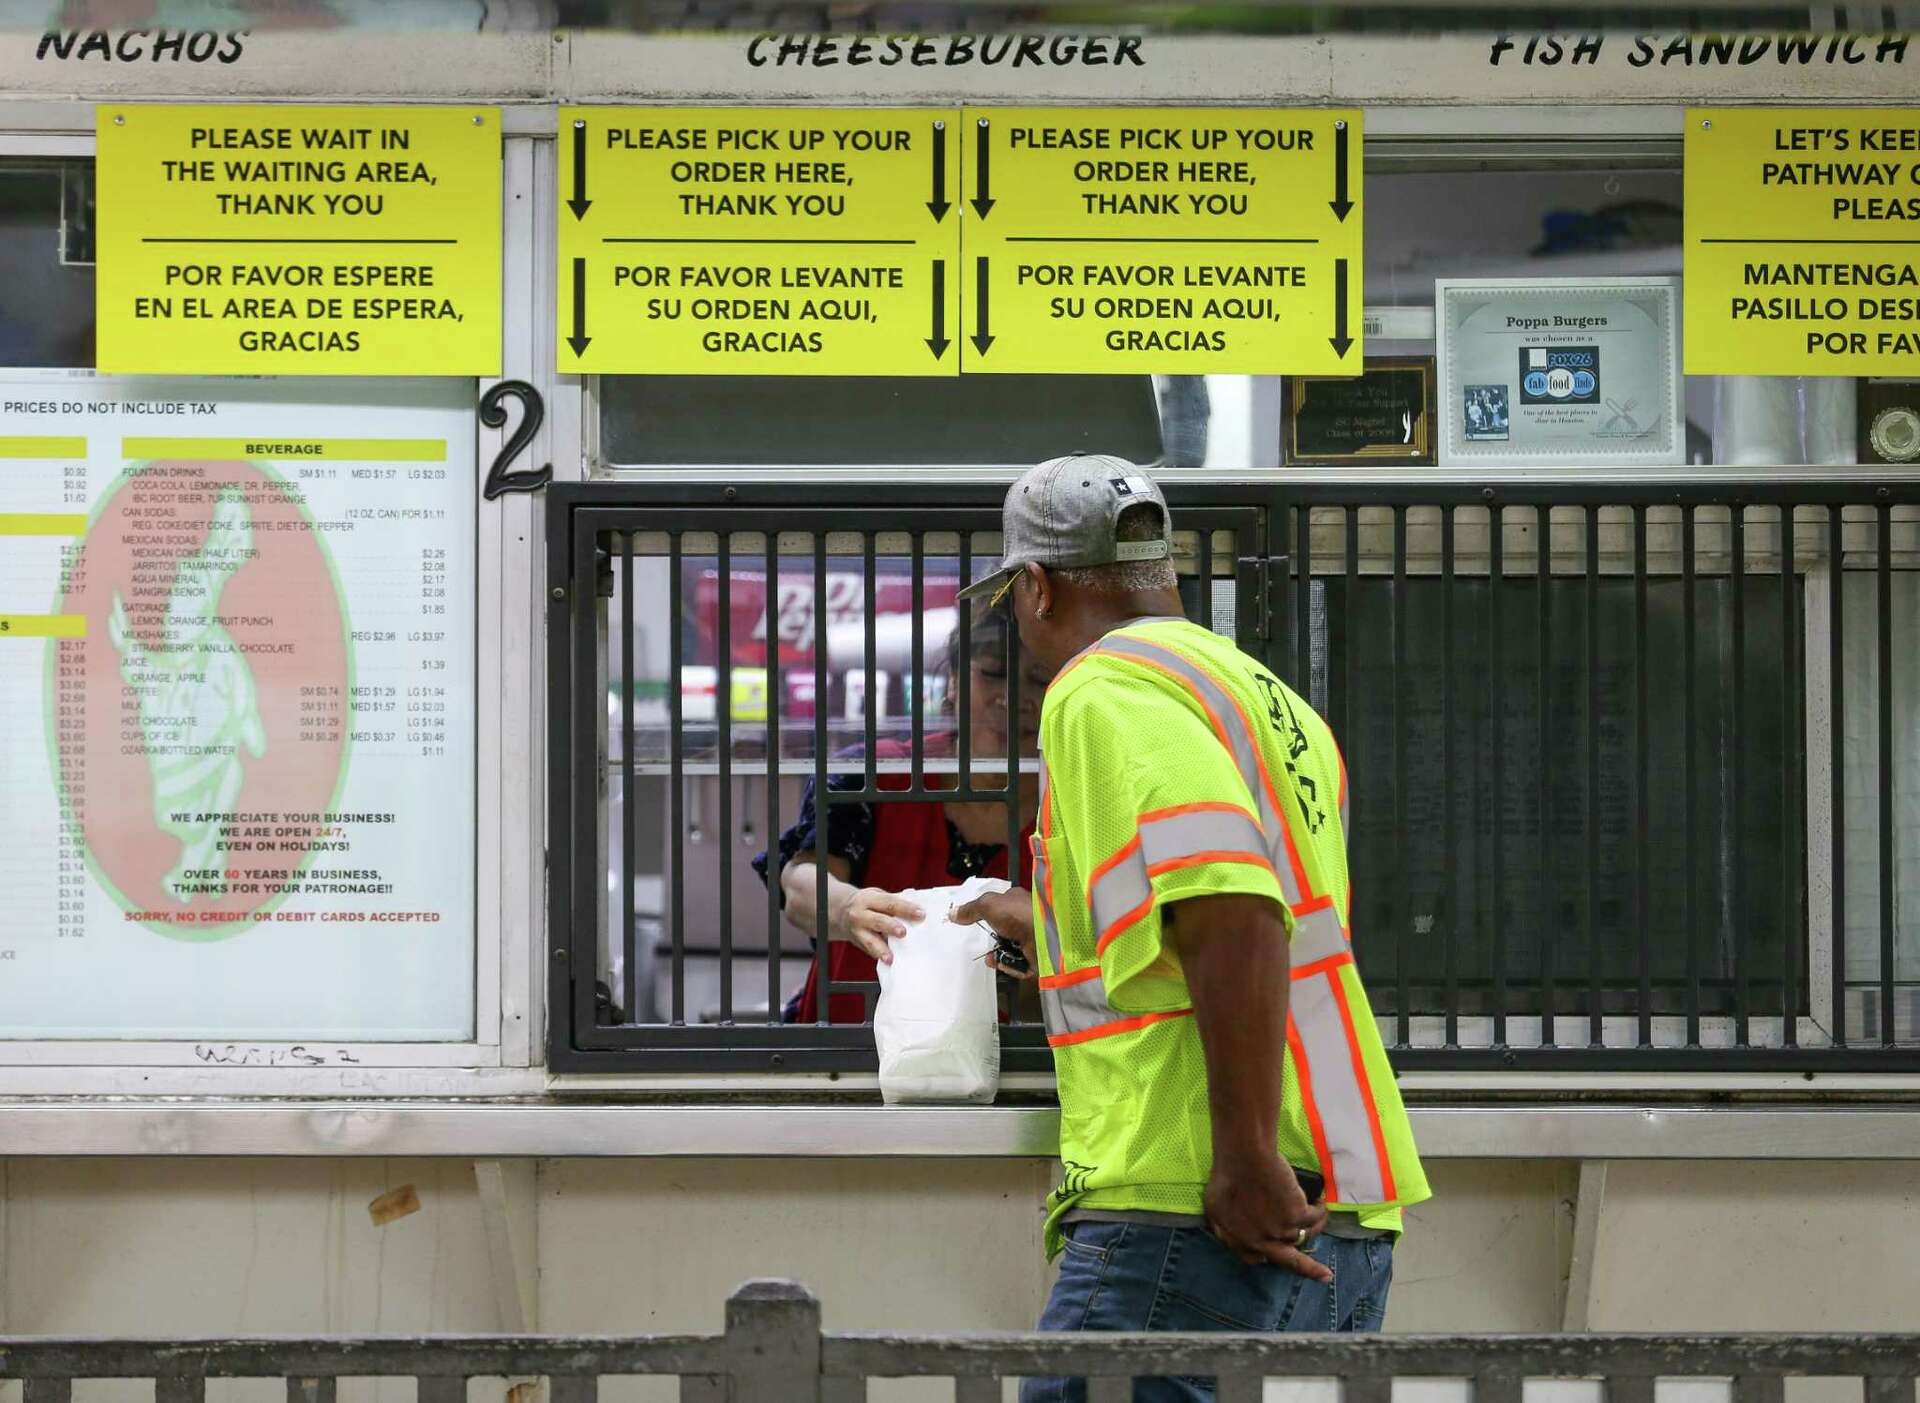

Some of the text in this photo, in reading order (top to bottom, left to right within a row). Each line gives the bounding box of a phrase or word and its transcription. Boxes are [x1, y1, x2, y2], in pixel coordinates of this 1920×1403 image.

[36, 29, 249, 64] NACHOS
[747, 33, 1146, 67] CHEESEBURGER
[1489, 32, 1911, 67] FISH SANDWICH
[191, 128, 409, 150] PLEASE WAIT IN
[607, 128, 911, 152] PLEASE PICK UP YOUR
[1010, 128, 1314, 151] PLEASE PICK UP YOUR
[1775, 128, 1920, 151] LET'S KEE
[161, 161, 437, 186] THE WAITING AREA,
[670, 161, 853, 186] ORDER HERE,
[1073, 160, 1256, 186] ORDER HERE,
[1762, 163, 1902, 186] PATHWAY
[216, 194, 383, 216] THANK YOU
[678, 194, 845, 216] THANK YOU
[1081, 193, 1248, 216] THANK YOU
[166, 265, 433, 287] POR FAVOR ESPERE
[615, 266, 903, 288] POR FAVOR LEVANTE
[1018, 264, 1306, 287] POR FAVOR LEVANTE
[1744, 263, 1919, 287] MANTENGA
[135, 298, 463, 322] EN EL AREA DE ESPERA,
[647, 298, 877, 323] SU ORDEN AQUI,
[1051, 297, 1280, 322] SU ORDEN AQUI,
[1732, 297, 1920, 321] PASILLO DES
[1506, 315, 1608, 329] Poppa Burgers
[239, 331, 360, 352] GRACIAS
[702, 331, 823, 353] GRACIAS
[1105, 330, 1226, 352] GRACIAS
[1807, 332, 1867, 355] POR
[1528, 377, 1545, 389] fab
[1549, 375, 1570, 390] food
[4, 402, 217, 414] PRICES DO NOT INCLUDE TAX
[246, 444, 323, 455] BEVERAGE
[479, 379, 553, 500] 2
[122, 468, 168, 478] FOUNTAIN
[170, 812, 396, 824] WE APPRECIATE YOUR BUSINESS!
[218, 827, 240, 837] WE
[243, 827, 271, 838] ARE
[274, 826, 312, 838] OPEN
[215, 840, 350, 852] EVEN ON HOLIDAYS!
[183, 869, 220, 880] OVER
[243, 869, 289, 880] YEARS
[291, 869, 307, 880] IN
[310, 869, 382, 882] BUSINESS,
[171, 883, 393, 895] THANKS FOR YOUR PATRONAGE!!
[124, 911, 441, 923] SORRY, NO CREDIT OR DEBIT CARDS ACCEPTED
